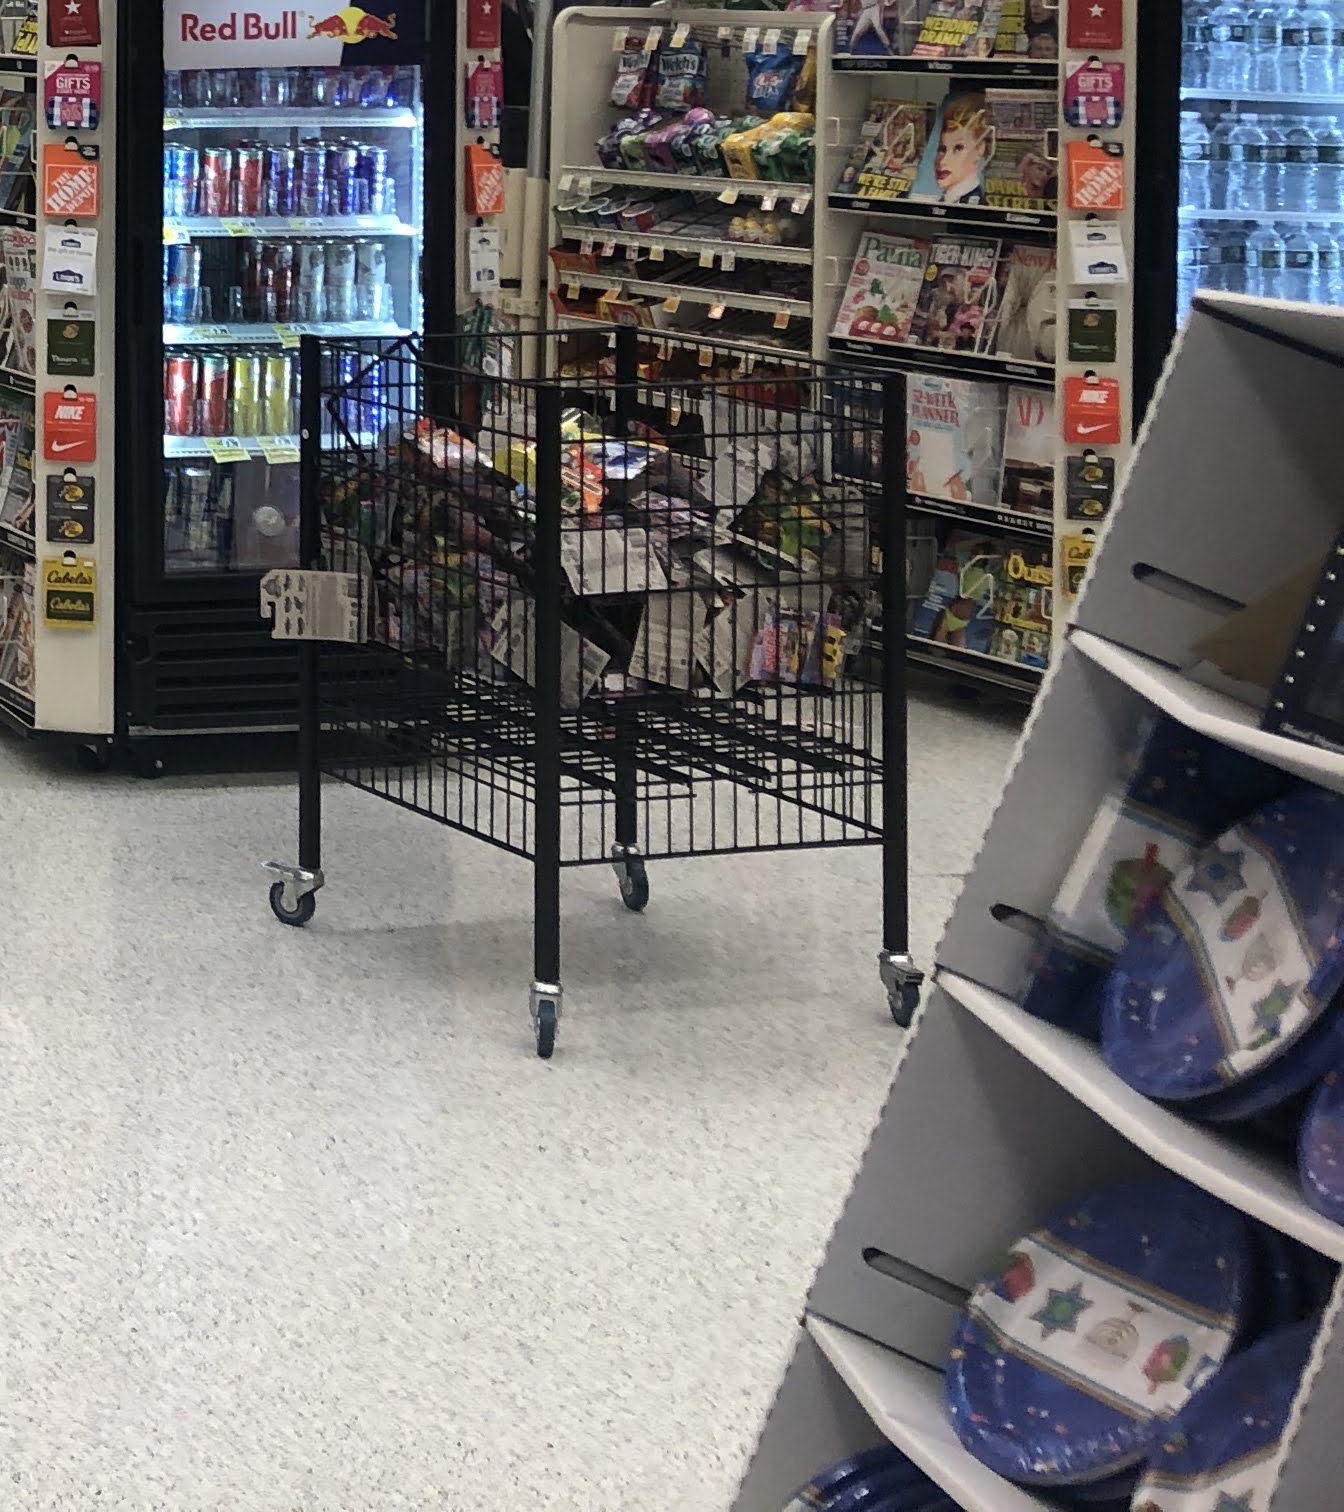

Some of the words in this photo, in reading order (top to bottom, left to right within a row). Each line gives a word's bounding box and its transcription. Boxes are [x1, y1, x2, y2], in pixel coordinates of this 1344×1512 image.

[180, 11, 237, 42] Red
[243, 10, 297, 39] Bull
[923, 16, 979, 34] WEDDING
[55, 77, 91, 89] GIFTS
[1078, 75, 1114, 88] GIFTS
[51, 170, 73, 188] THE
[46, 165, 96, 213] HOME
[54, 405, 85, 420] NIKE
